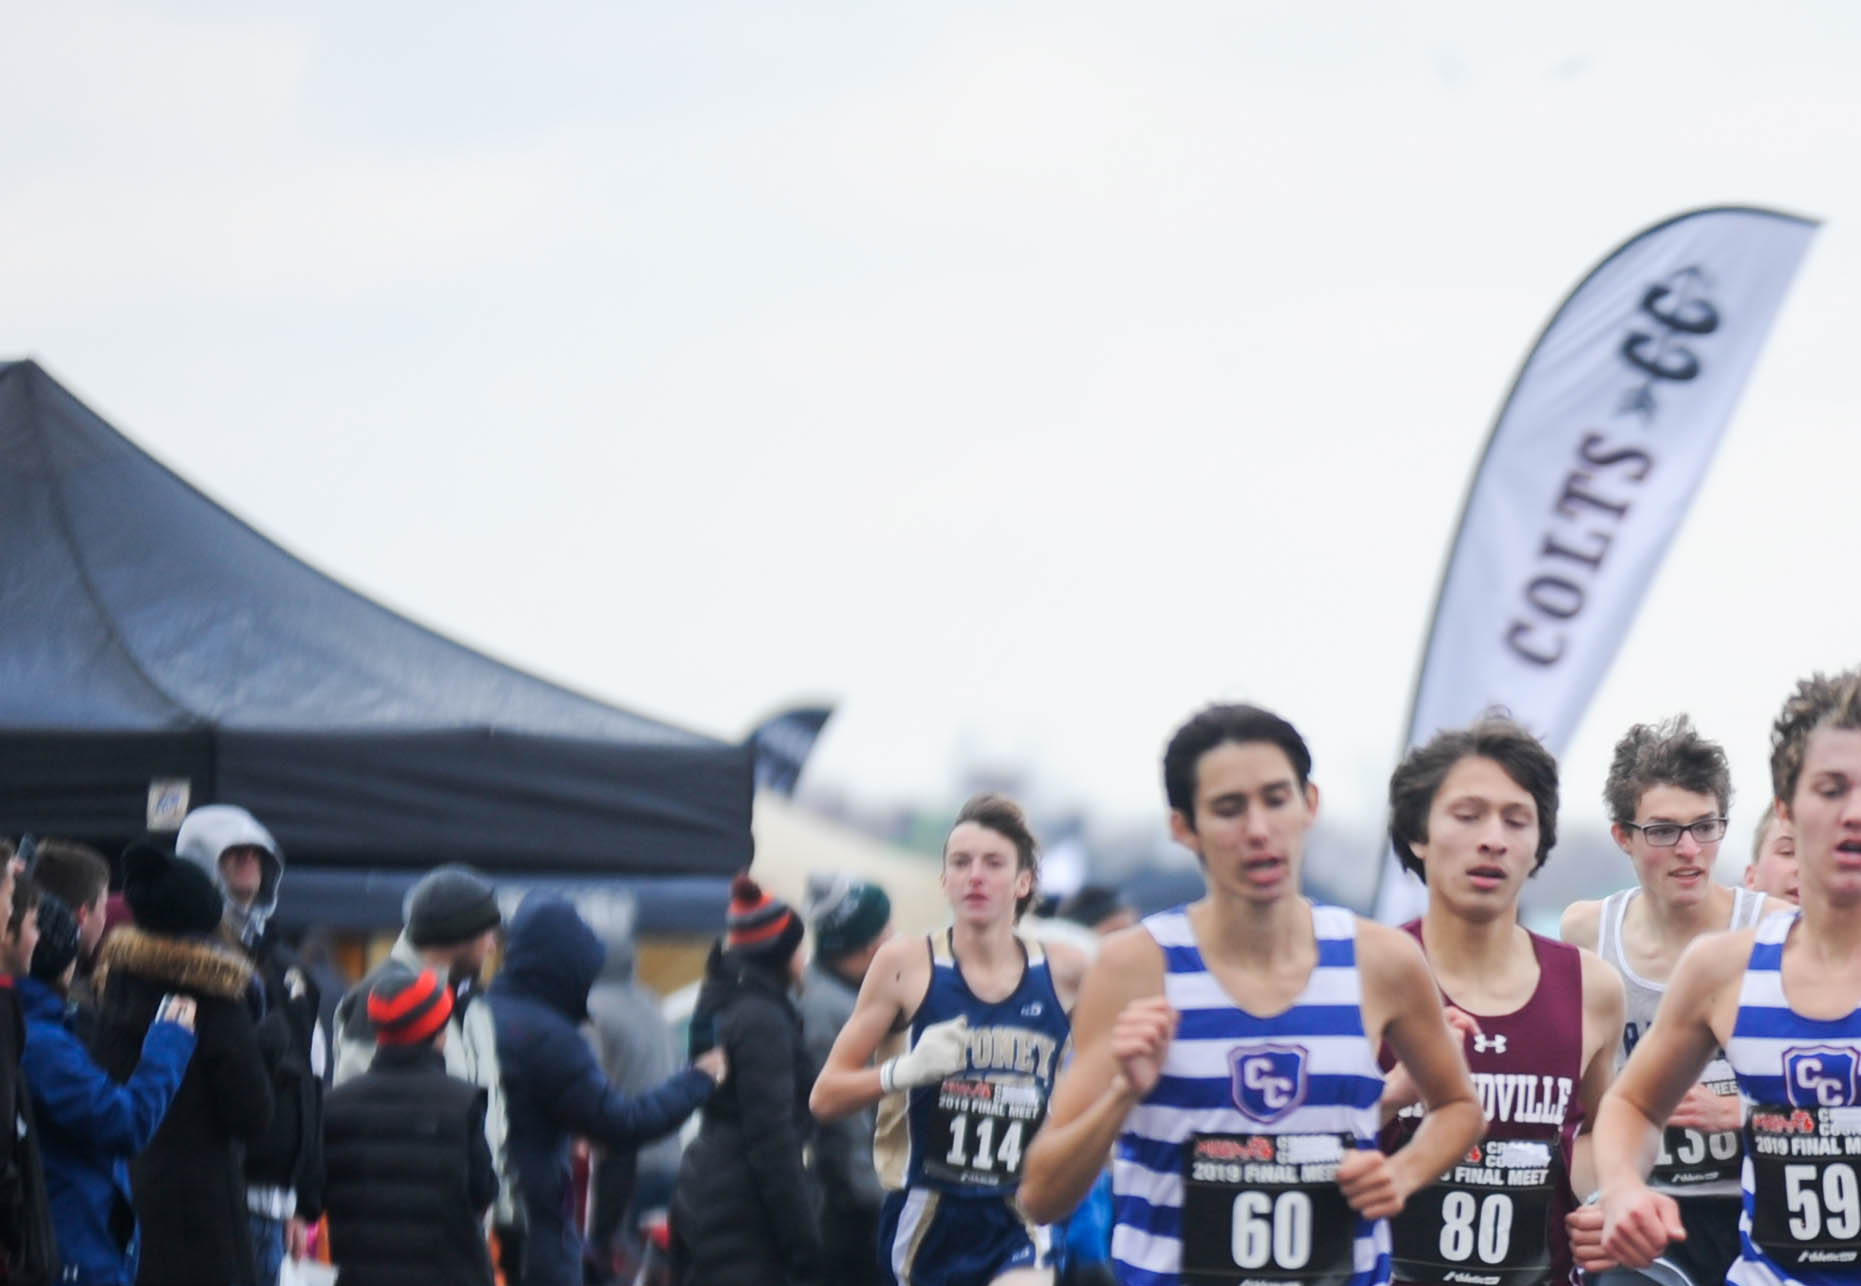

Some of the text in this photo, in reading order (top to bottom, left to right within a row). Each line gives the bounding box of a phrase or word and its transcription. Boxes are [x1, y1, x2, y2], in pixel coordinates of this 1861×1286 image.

[1504, 431, 1655, 669] COLTS
[965, 1025, 1057, 1081] TONEY
[1244, 1057, 1293, 1108] CC
[1399, 1073, 1573, 1125] DVILLE
[1795, 1058, 1843, 1107] CC
[946, 1112, 1023, 1173] 114
[1756, 1136, 1789, 1156] 2019
[1790, 1136, 1842, 1156] FINAL
[1192, 1161, 1242, 1182] 2019
[1243, 1163, 1300, 1184] FINAL
[1454, 1166, 1505, 1186] FINAL
[1507, 1169, 1550, 1187] MEET
[1438, 1191, 1514, 1264] 80
[1784, 1163, 1861, 1241] 59
[1231, 1190, 1313, 1271] 60
